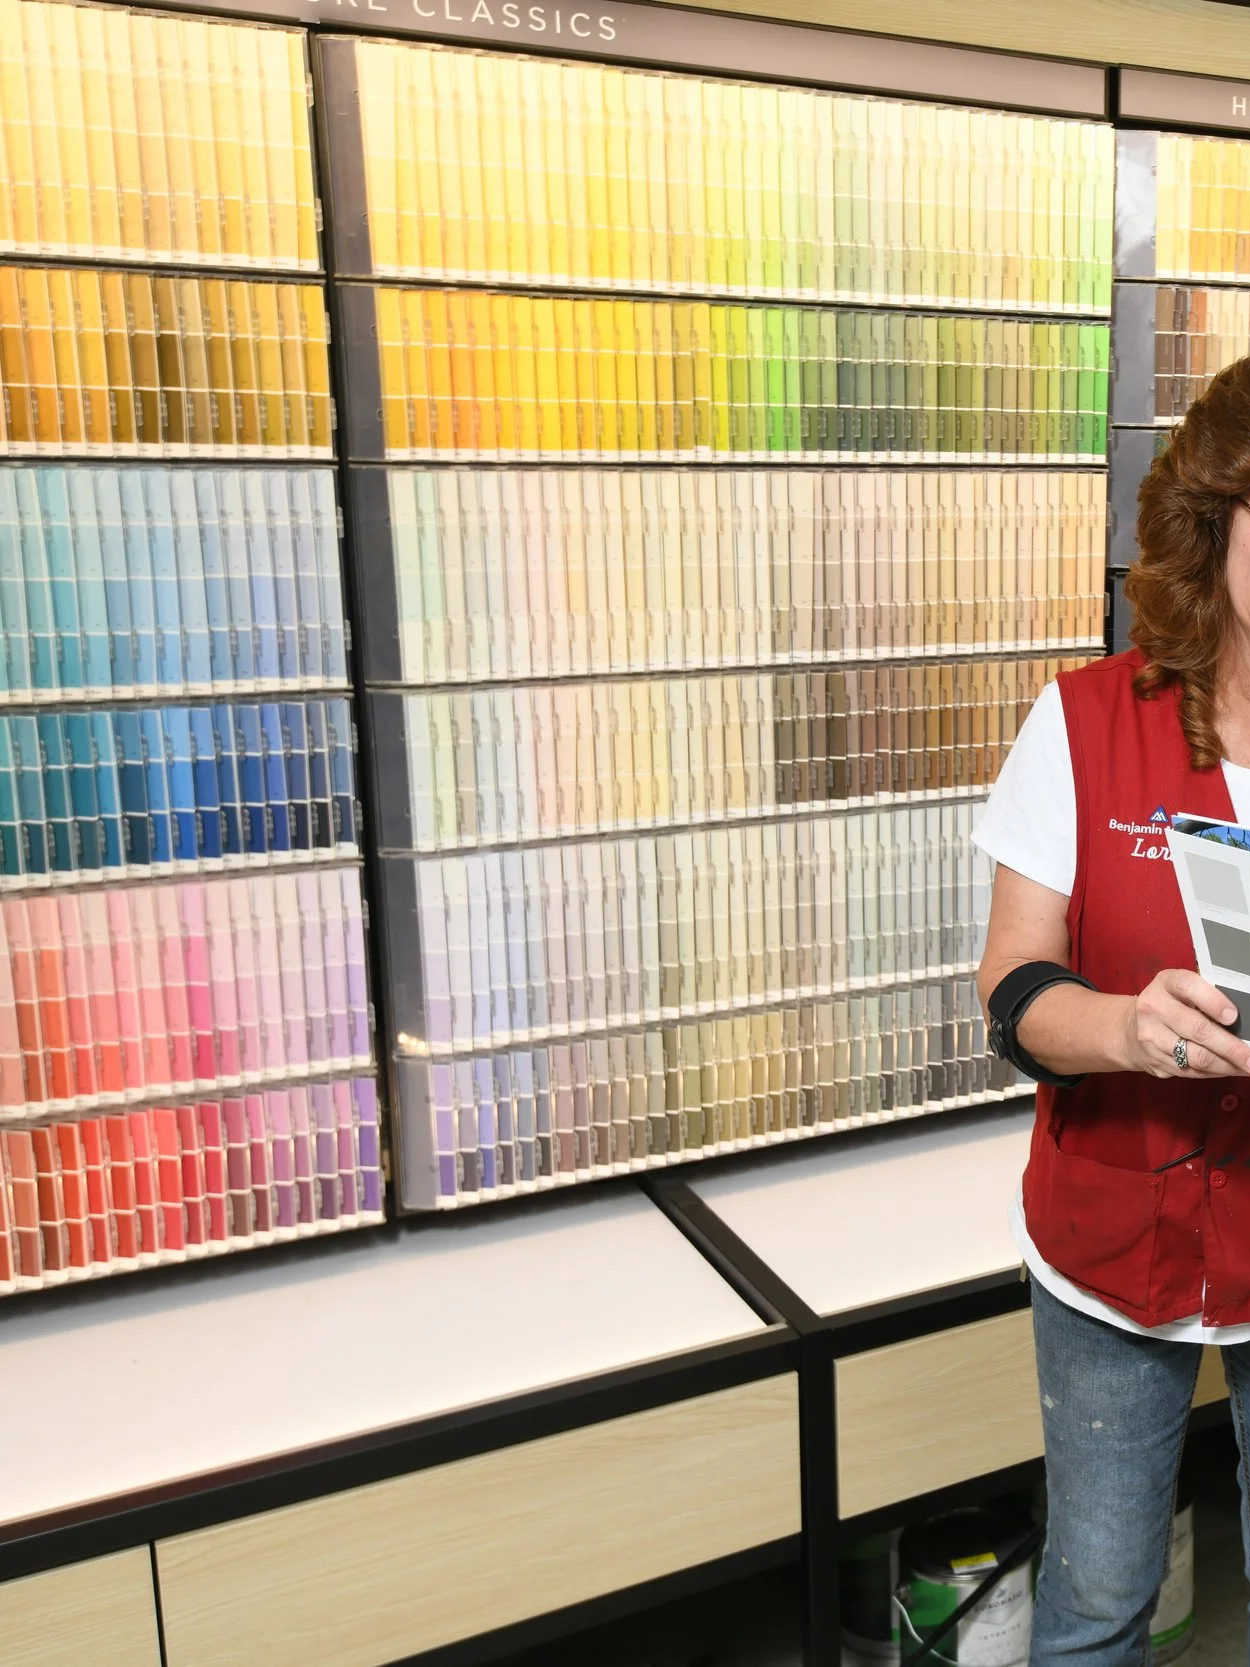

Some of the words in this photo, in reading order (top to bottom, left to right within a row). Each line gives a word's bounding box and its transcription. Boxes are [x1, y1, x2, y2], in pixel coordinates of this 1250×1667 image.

[412, 0, 617, 41] CLASSICS
[1108, 818, 1163, 836] Benjamin
[1130, 837, 1173, 862] Lor
